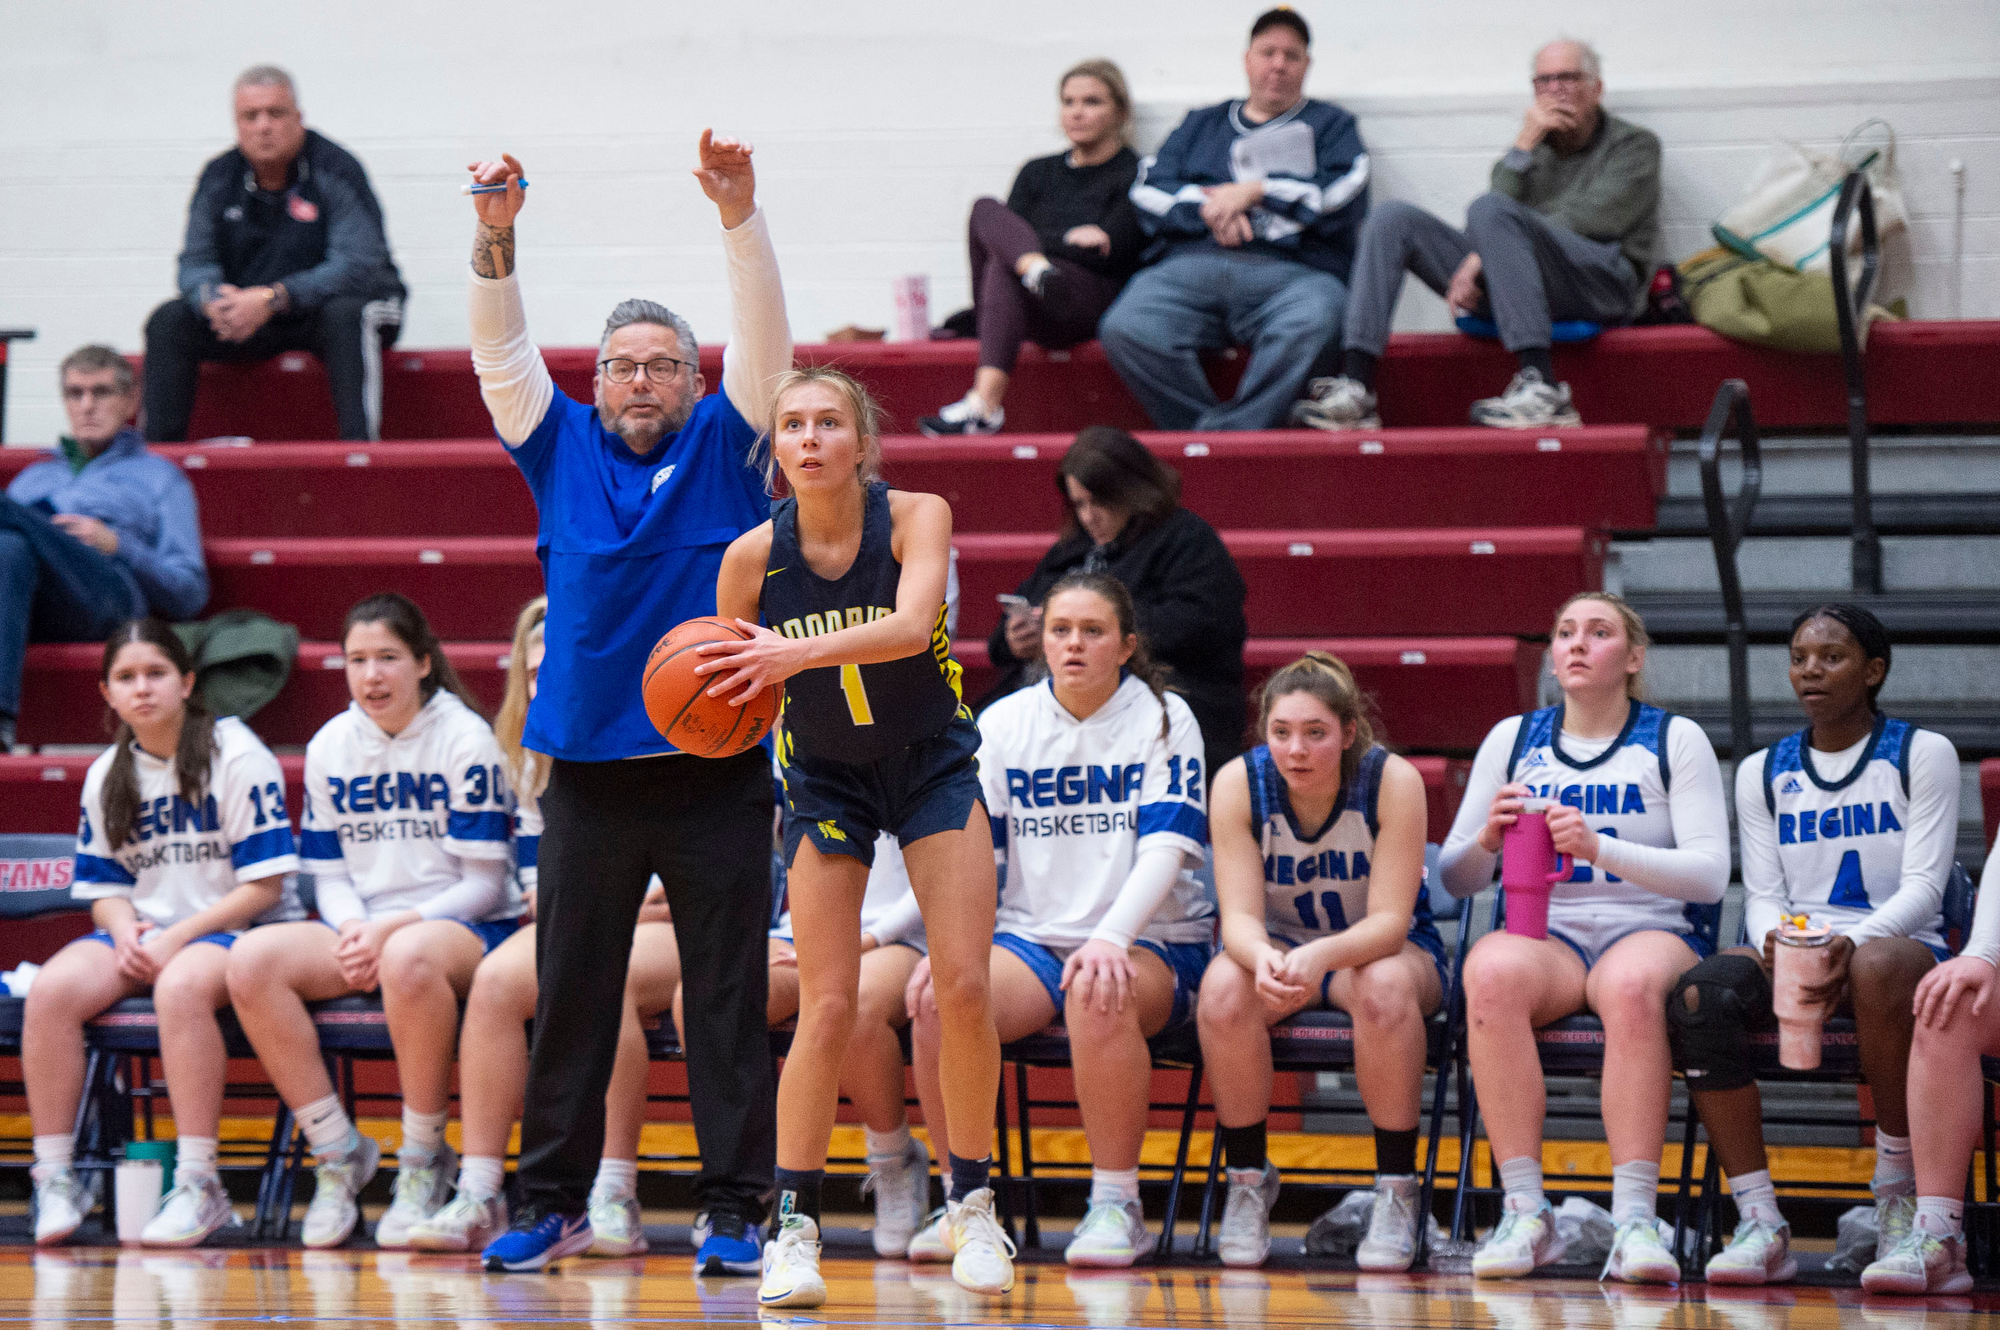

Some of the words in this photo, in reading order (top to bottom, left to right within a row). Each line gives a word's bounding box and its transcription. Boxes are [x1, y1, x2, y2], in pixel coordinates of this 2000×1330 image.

[841, 664, 874, 726] 1
[1006, 763, 1145, 808] REGINA
[1167, 754, 1201, 803] 12
[249, 781, 289, 827] 13
[1778, 800, 1902, 845] REGINA
[1294, 890, 1350, 931] 11
